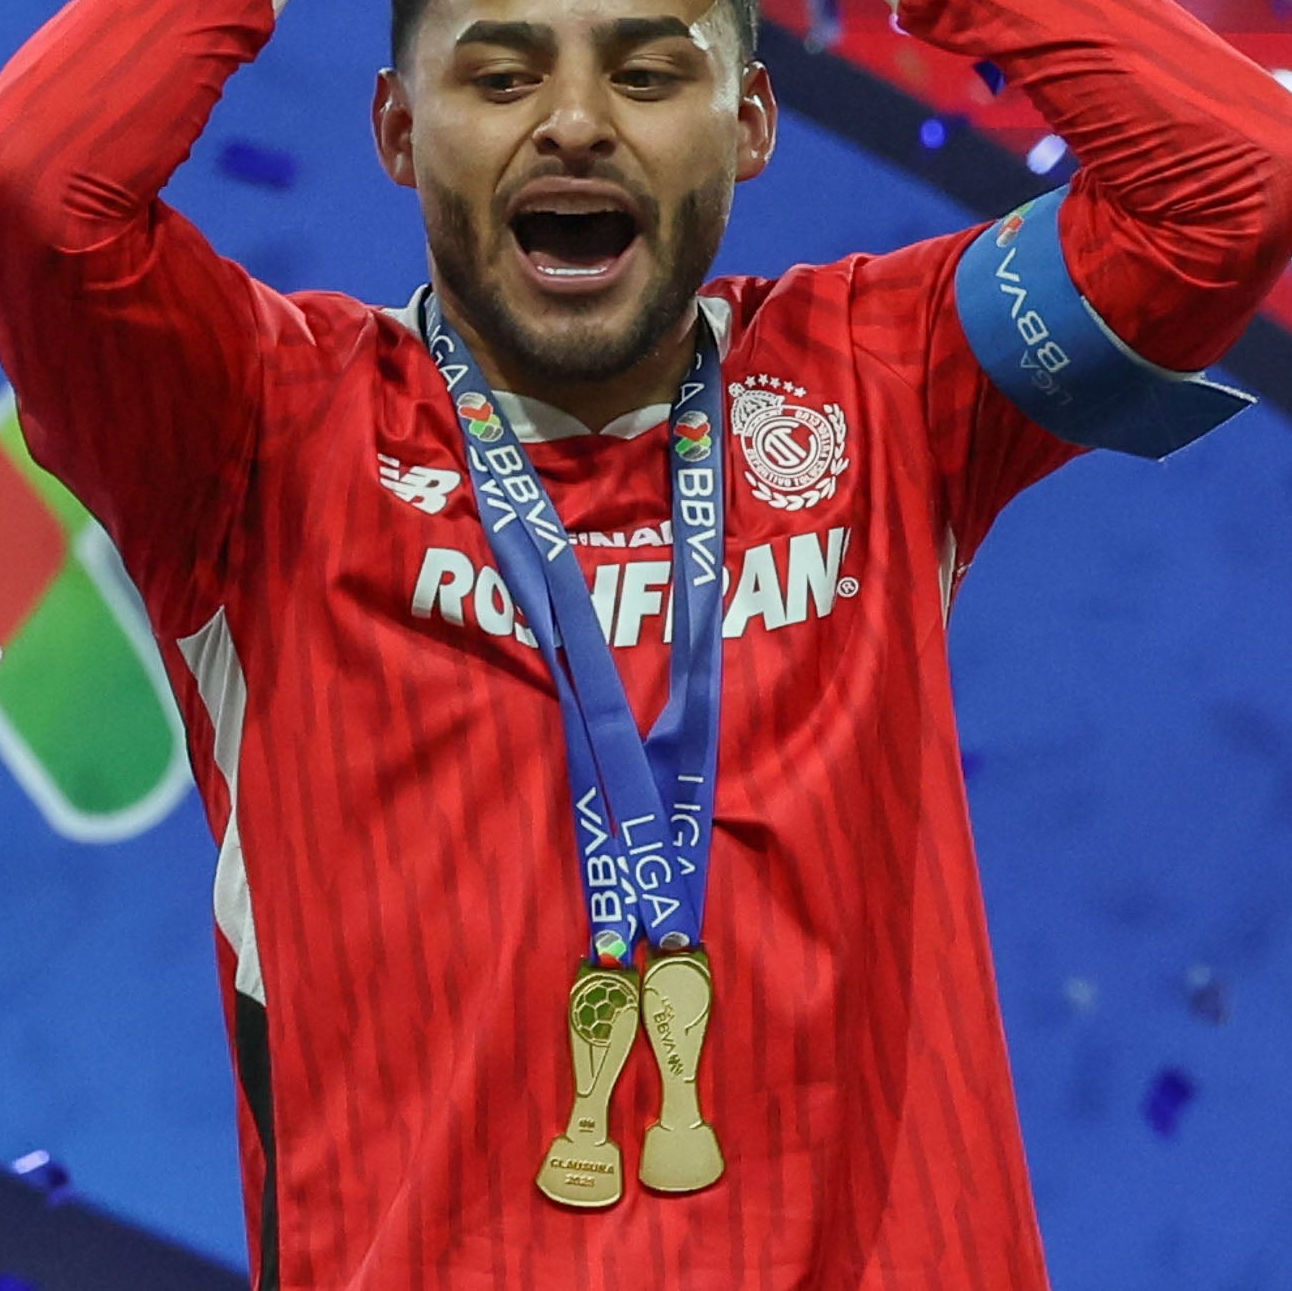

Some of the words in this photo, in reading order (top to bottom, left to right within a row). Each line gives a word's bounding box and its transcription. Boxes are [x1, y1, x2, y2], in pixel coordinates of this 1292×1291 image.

[995, 247, 1071, 374] BBVA
[485, 444, 568, 563] BBVA
[678, 468, 717, 588] BBVA
[575, 787, 623, 923] BBVA
[620, 814, 681, 929] LIGA
